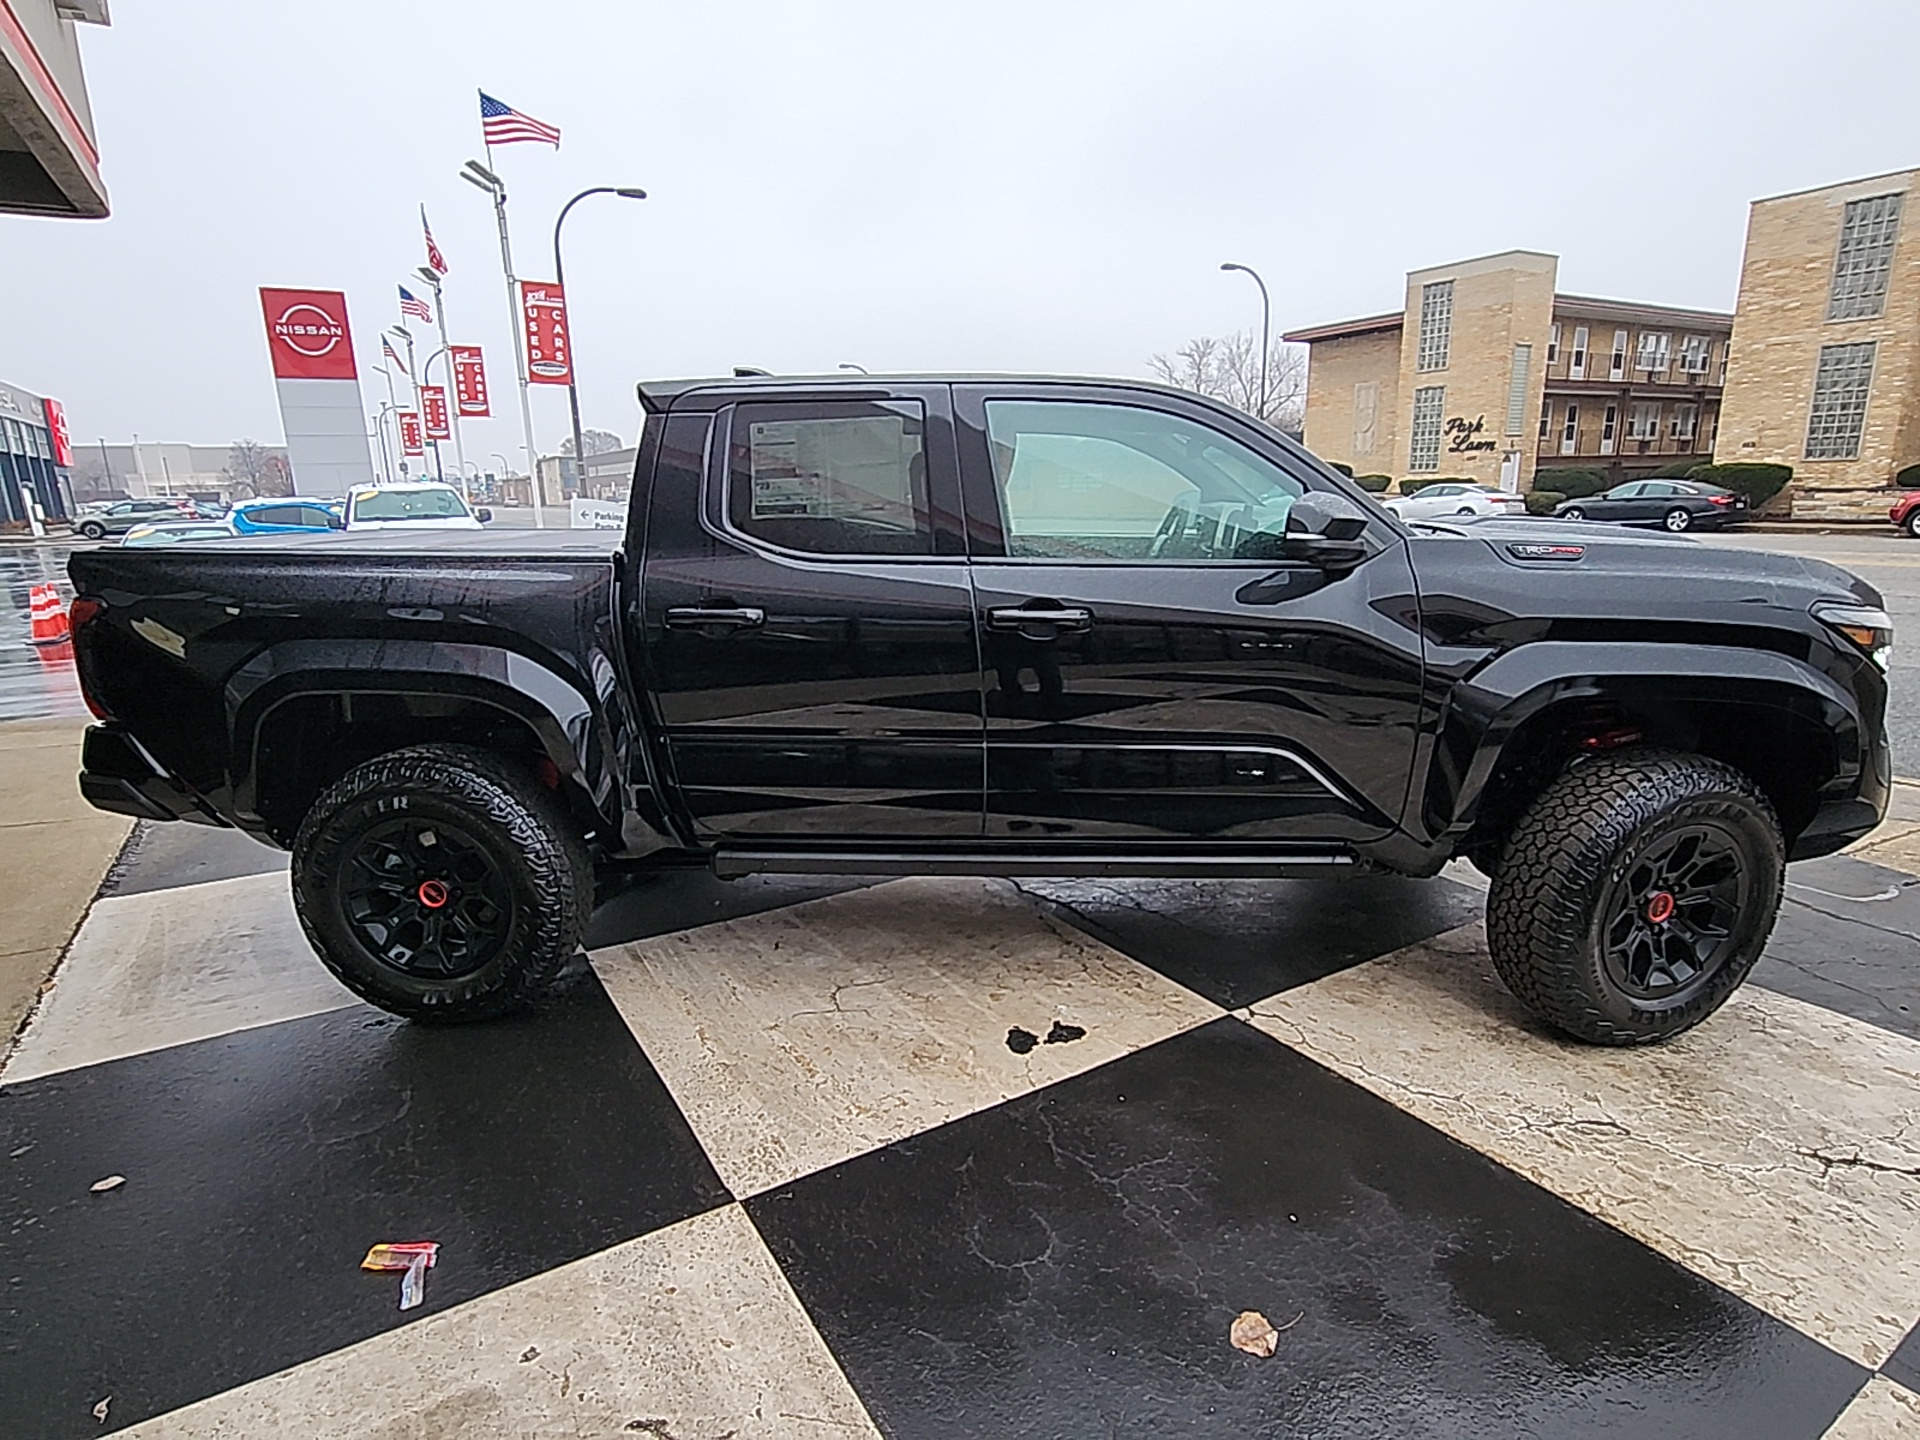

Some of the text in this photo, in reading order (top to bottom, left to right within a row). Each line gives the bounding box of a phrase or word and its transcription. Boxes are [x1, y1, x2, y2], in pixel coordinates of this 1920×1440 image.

[275, 325, 343, 335] NISSAN
[527, 307, 542, 360] USED
[551, 309, 565, 361] CARS
[1443, 414, 1485, 436] Park
[594, 511, 625, 523] Parking
